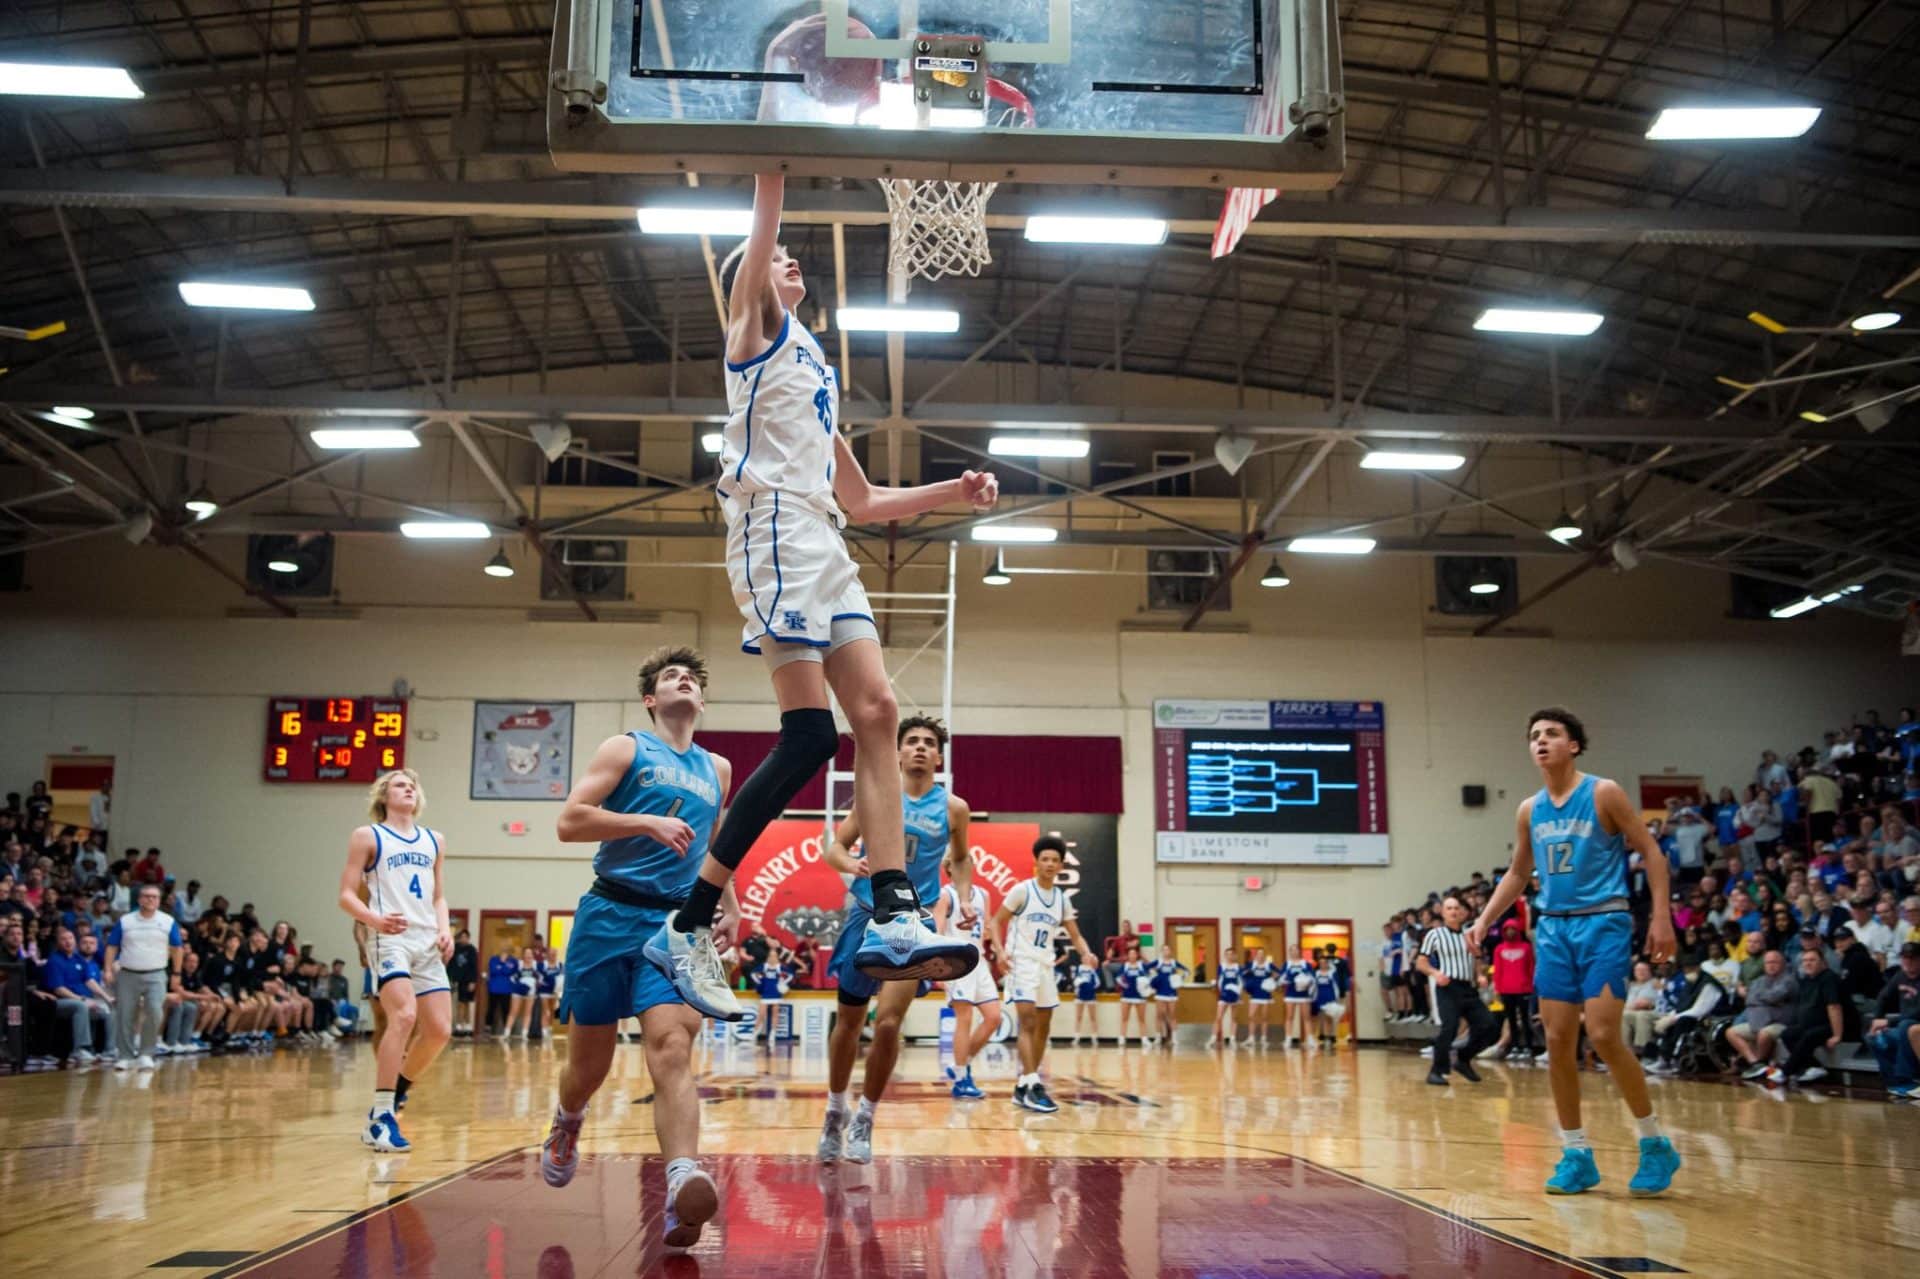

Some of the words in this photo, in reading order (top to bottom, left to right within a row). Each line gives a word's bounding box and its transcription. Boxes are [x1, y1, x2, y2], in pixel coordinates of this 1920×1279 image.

[281, 711, 302, 736] 16
[373, 712, 402, 736] 29
[354, 729, 367, 748] 2
[275, 746, 288, 766] 3
[382, 748, 395, 767] 6
[1190, 838, 1270, 848] LIMESTONE
[1191, 849, 1225, 858] BANK
[1547, 841, 1574, 876] 12
[969, 845, 1021, 897] SCHO
[409, 873, 423, 899] 4
[740, 845, 801, 923] HENRY
